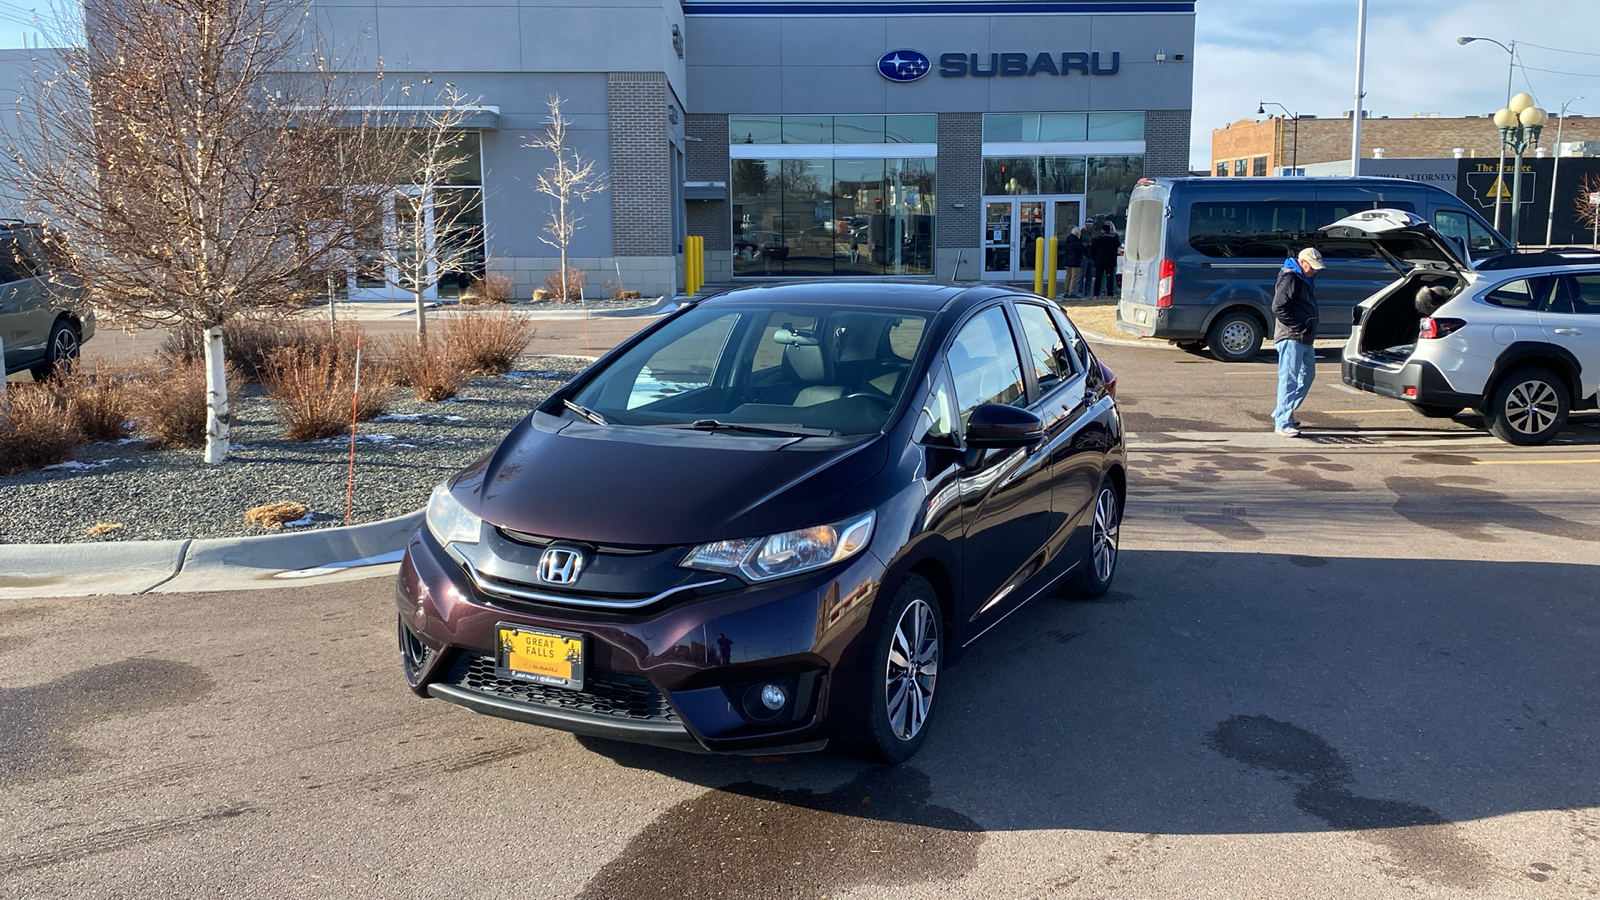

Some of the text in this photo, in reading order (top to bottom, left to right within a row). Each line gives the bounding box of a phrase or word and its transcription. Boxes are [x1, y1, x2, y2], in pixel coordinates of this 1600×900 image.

[940, 52, 1120, 77] SUBARU
[1476, 163, 1532, 172] The Pracce
[1404, 173, 1457, 181] ATTORNEYS
[526, 636, 554, 648] GREAT
[526, 646, 554, 659] FALLS
[532, 664, 558, 673] SUBARU
